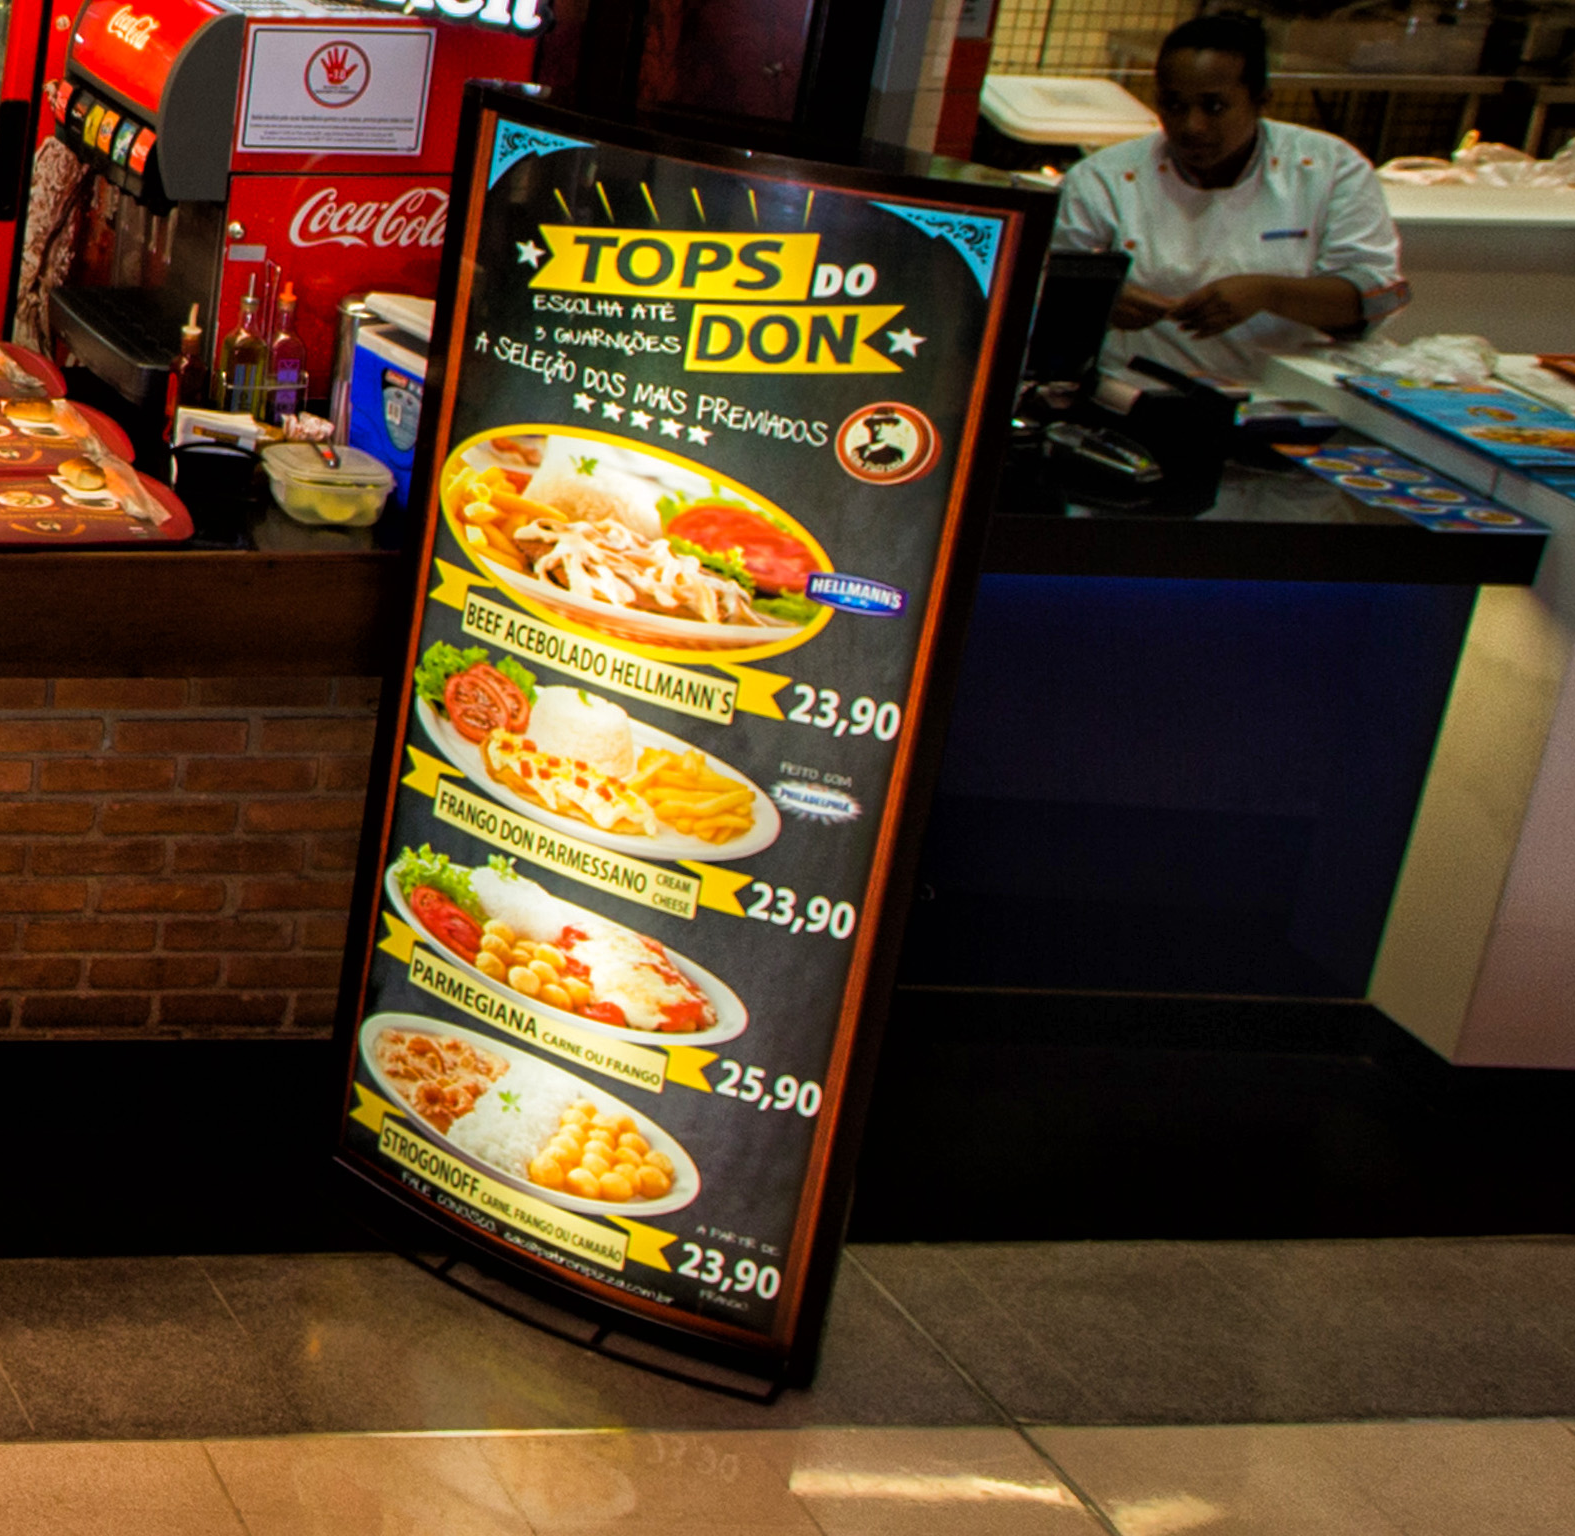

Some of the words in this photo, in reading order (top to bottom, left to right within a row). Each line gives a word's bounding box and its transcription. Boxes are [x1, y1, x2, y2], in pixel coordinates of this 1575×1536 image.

[571, 235, 784, 291] TOPS
[812, 263, 878, 299] DO
[532, 294, 623, 319] ESCOLHA
[630, 302, 678, 322] ATÉ
[534, 326, 546, 342] 3
[694, 313, 860, 365] DON
[474, 330, 490, 353] A
[493, 335, 577, 384] SELEÇÃO
[582, 367, 627, 398] DOS
[633, 383, 688, 415] MAIS
[697, 394, 829, 447] PREMIADOS
[810, 576, 904, 610] HELLMANN'S
[465, 600, 503, 638] BEEF
[503, 616, 607, 677] ACEBOLADO
[787, 682, 901, 742] 23,90
[438, 791, 498, 837] FRANGO
[498, 817, 534, 849] DON
[535, 836, 648, 895] PARMESSANO
[651, 892, 690, 916] CHEESE
[655, 872, 692, 895] CREAM
[747, 881, 857, 941] 23,90
[411, 958, 539, 1040] PARMEGIANA
[541, 1031, 583, 1060] CARNE
[583, 1048, 605, 1067] OU
[606, 1054, 661, 1089] FRANGO
[715, 1059, 823, 1118] 25,90
[382, 1124, 481, 1200] STROGONOFF
[513, 1207, 555, 1236] FRANGO
[554, 1227, 570, 1244] OU
[570, 1232, 623, 1265] CAMARÃO
[676, 1241, 782, 1300] 23,90
